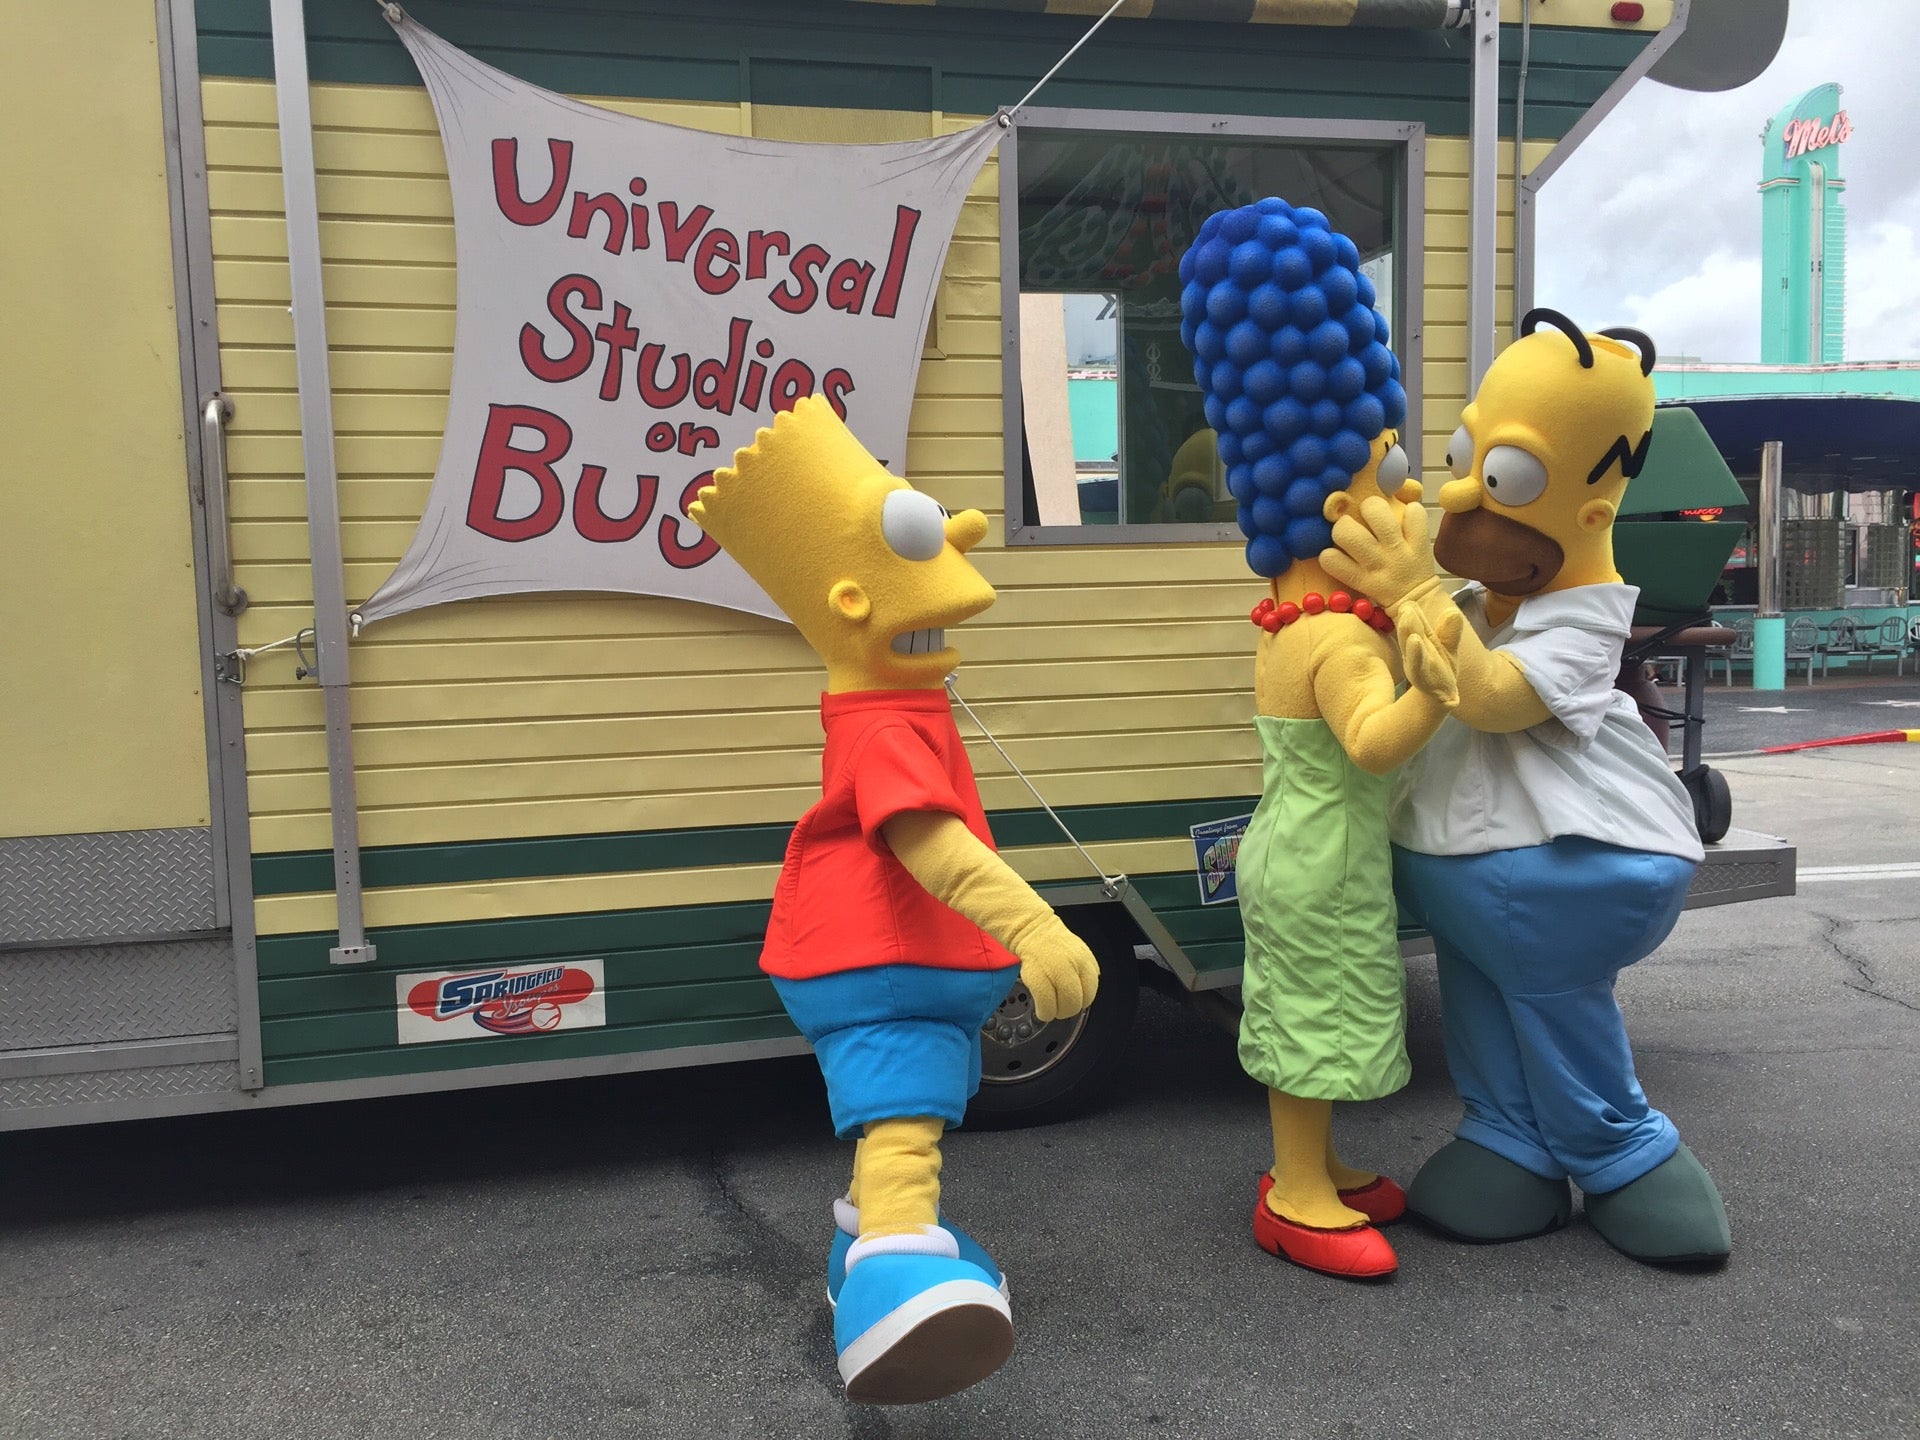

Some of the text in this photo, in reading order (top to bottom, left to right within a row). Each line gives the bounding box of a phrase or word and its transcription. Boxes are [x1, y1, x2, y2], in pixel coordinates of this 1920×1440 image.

[1783, 110, 1853, 159] Mel's
[491, 137, 921, 318] Universal
[466, 403, 889, 569] Bus
[645, 421, 720, 457] or
